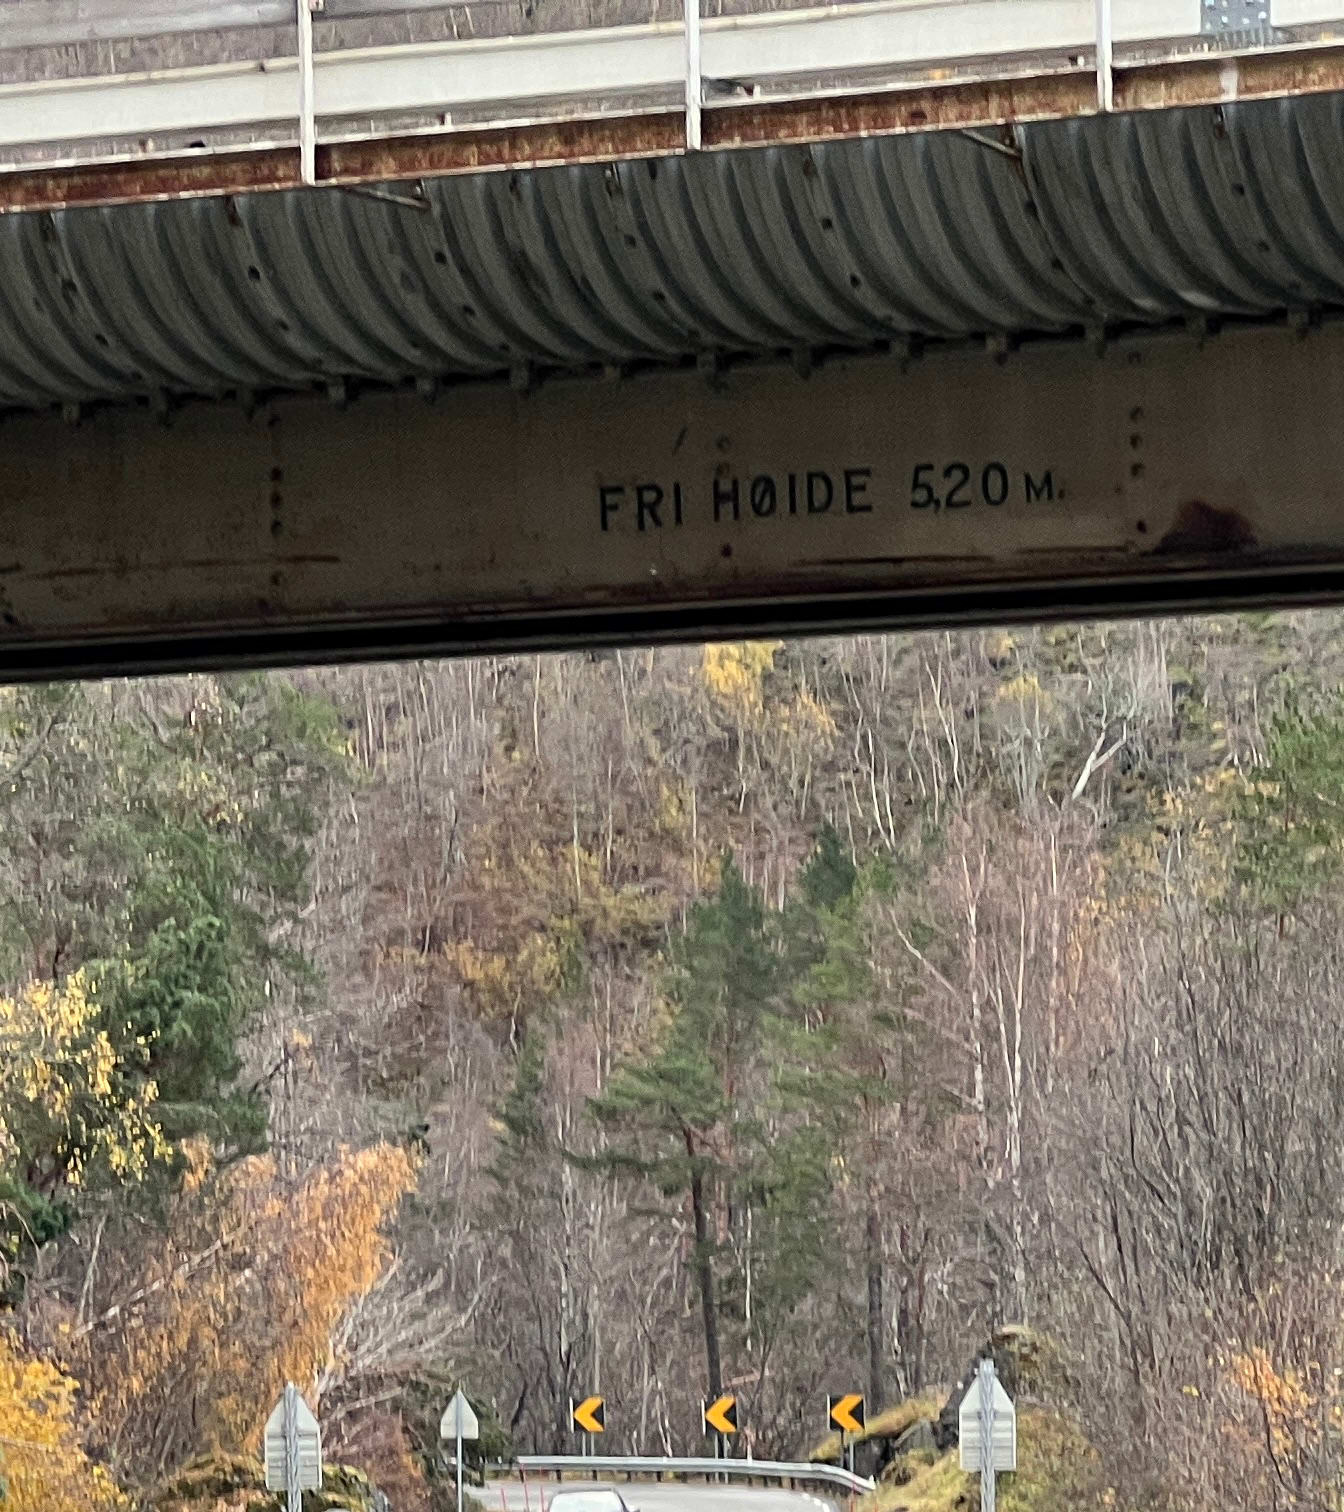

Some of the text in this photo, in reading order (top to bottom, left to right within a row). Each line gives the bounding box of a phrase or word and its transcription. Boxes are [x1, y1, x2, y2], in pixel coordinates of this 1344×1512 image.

[598, 482, 683, 531] FRI
[713, 468, 874, 523] HØIDE
[910, 461, 1009, 514] 5,20
